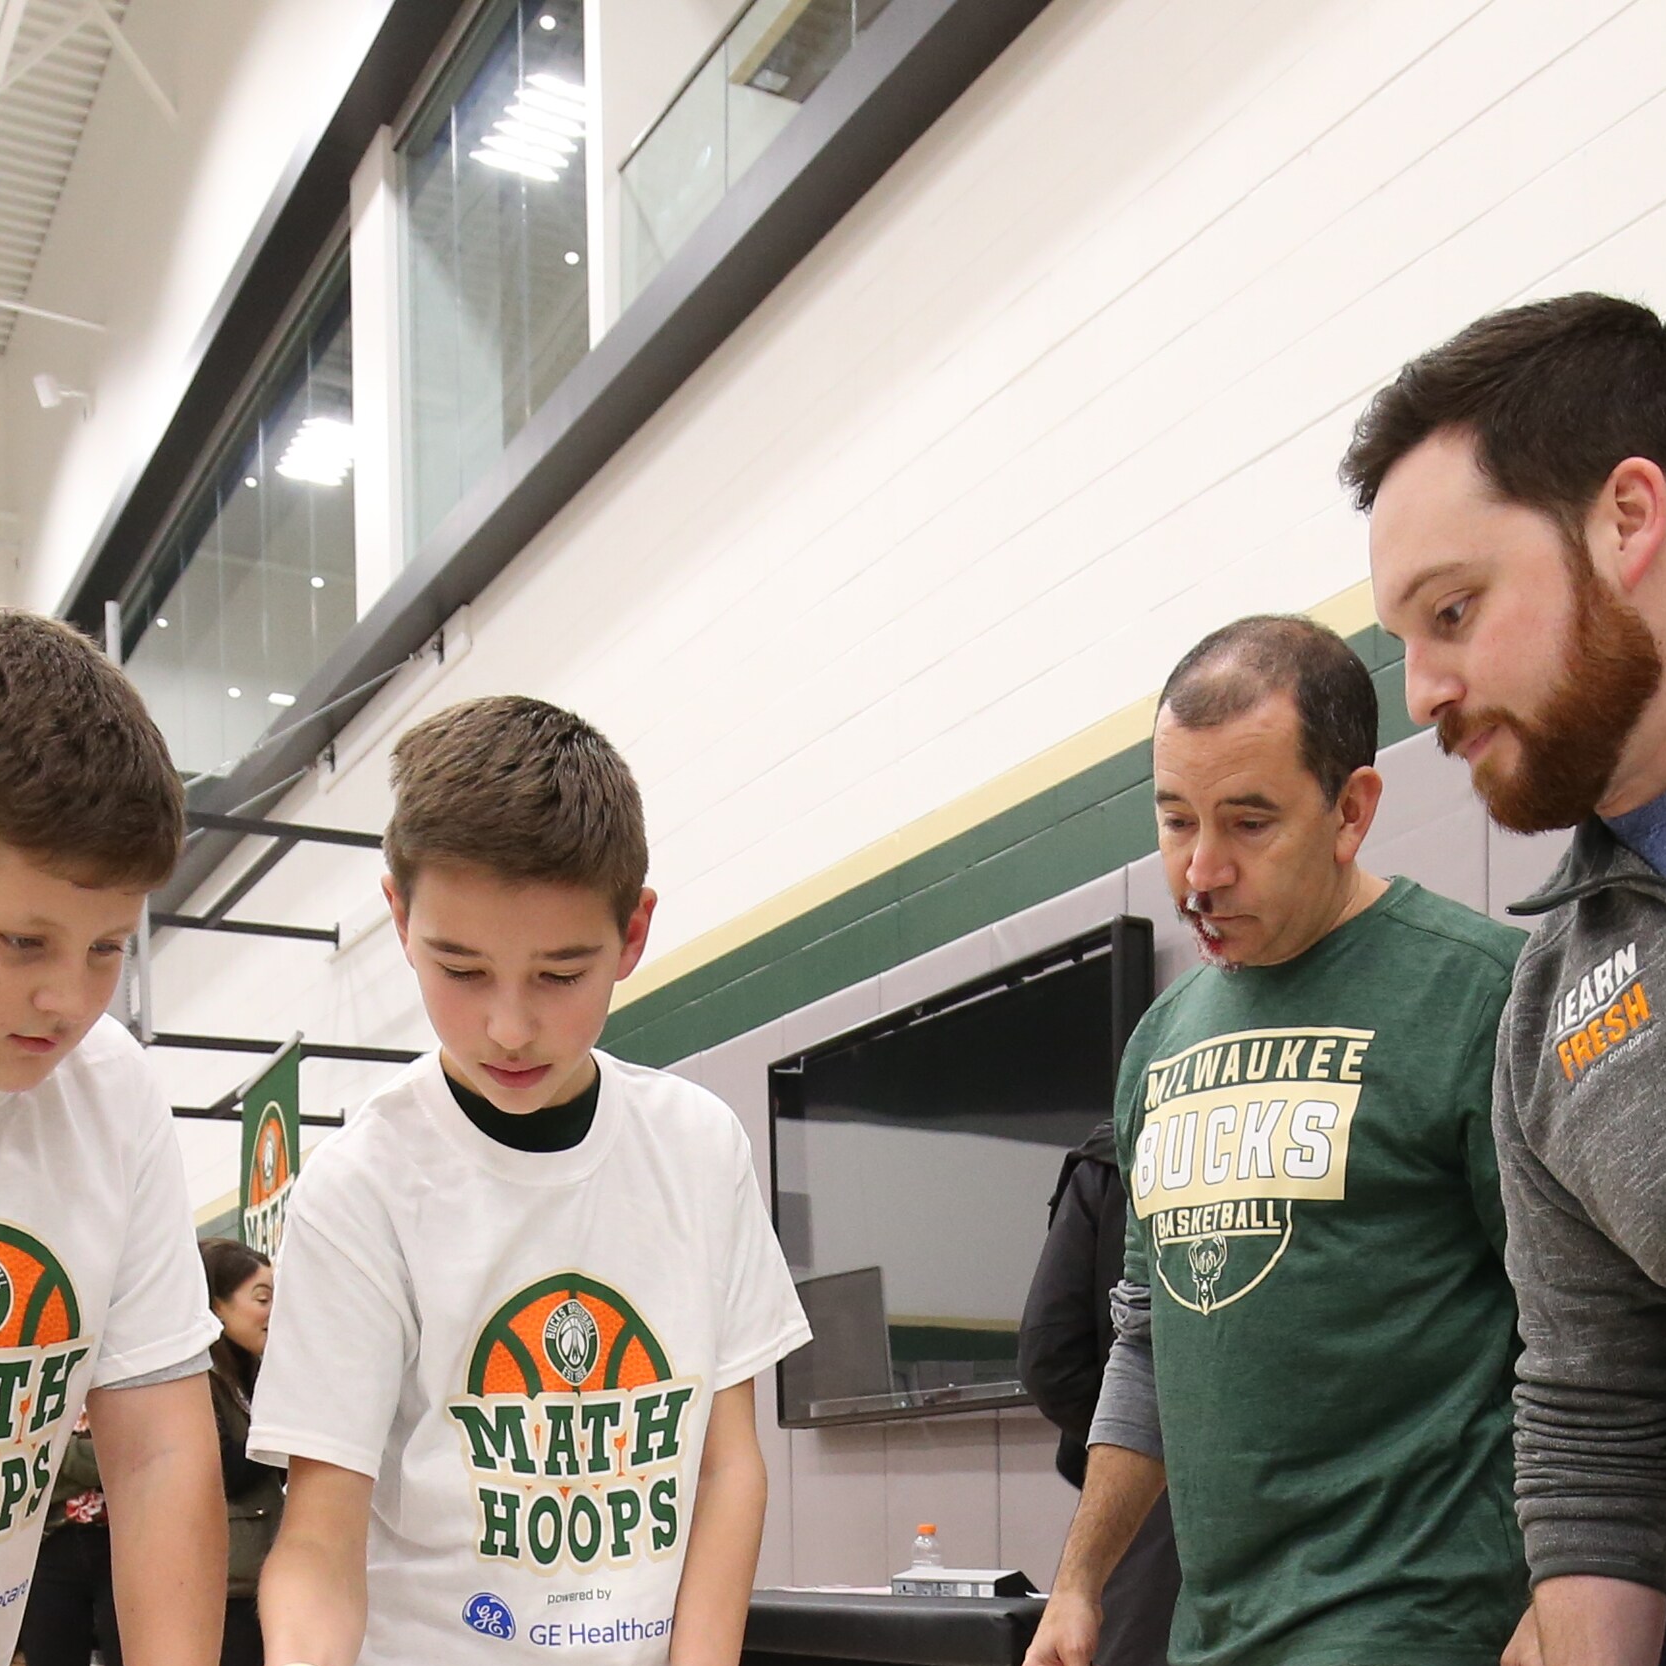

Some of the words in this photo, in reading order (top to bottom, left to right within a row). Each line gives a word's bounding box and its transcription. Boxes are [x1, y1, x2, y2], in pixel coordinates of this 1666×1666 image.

[1556, 942, 1637, 1033] LEARN
[1145, 1039, 1370, 1112] MILWAUKEE
[1556, 982, 1651, 1083] FRESH
[1135, 1100, 1340, 1200] BUCKS
[1157, 1200, 1281, 1238] BASKETBALL
[448, 1388, 694, 1476] MATH
[479, 1477, 678, 1565] HOOPS
[529, 1624, 561, 1646] GE
[569, 1617, 674, 1645] Healthcar
[546, 1590, 594, 1605] powered
[597, 1588, 612, 1601] by
